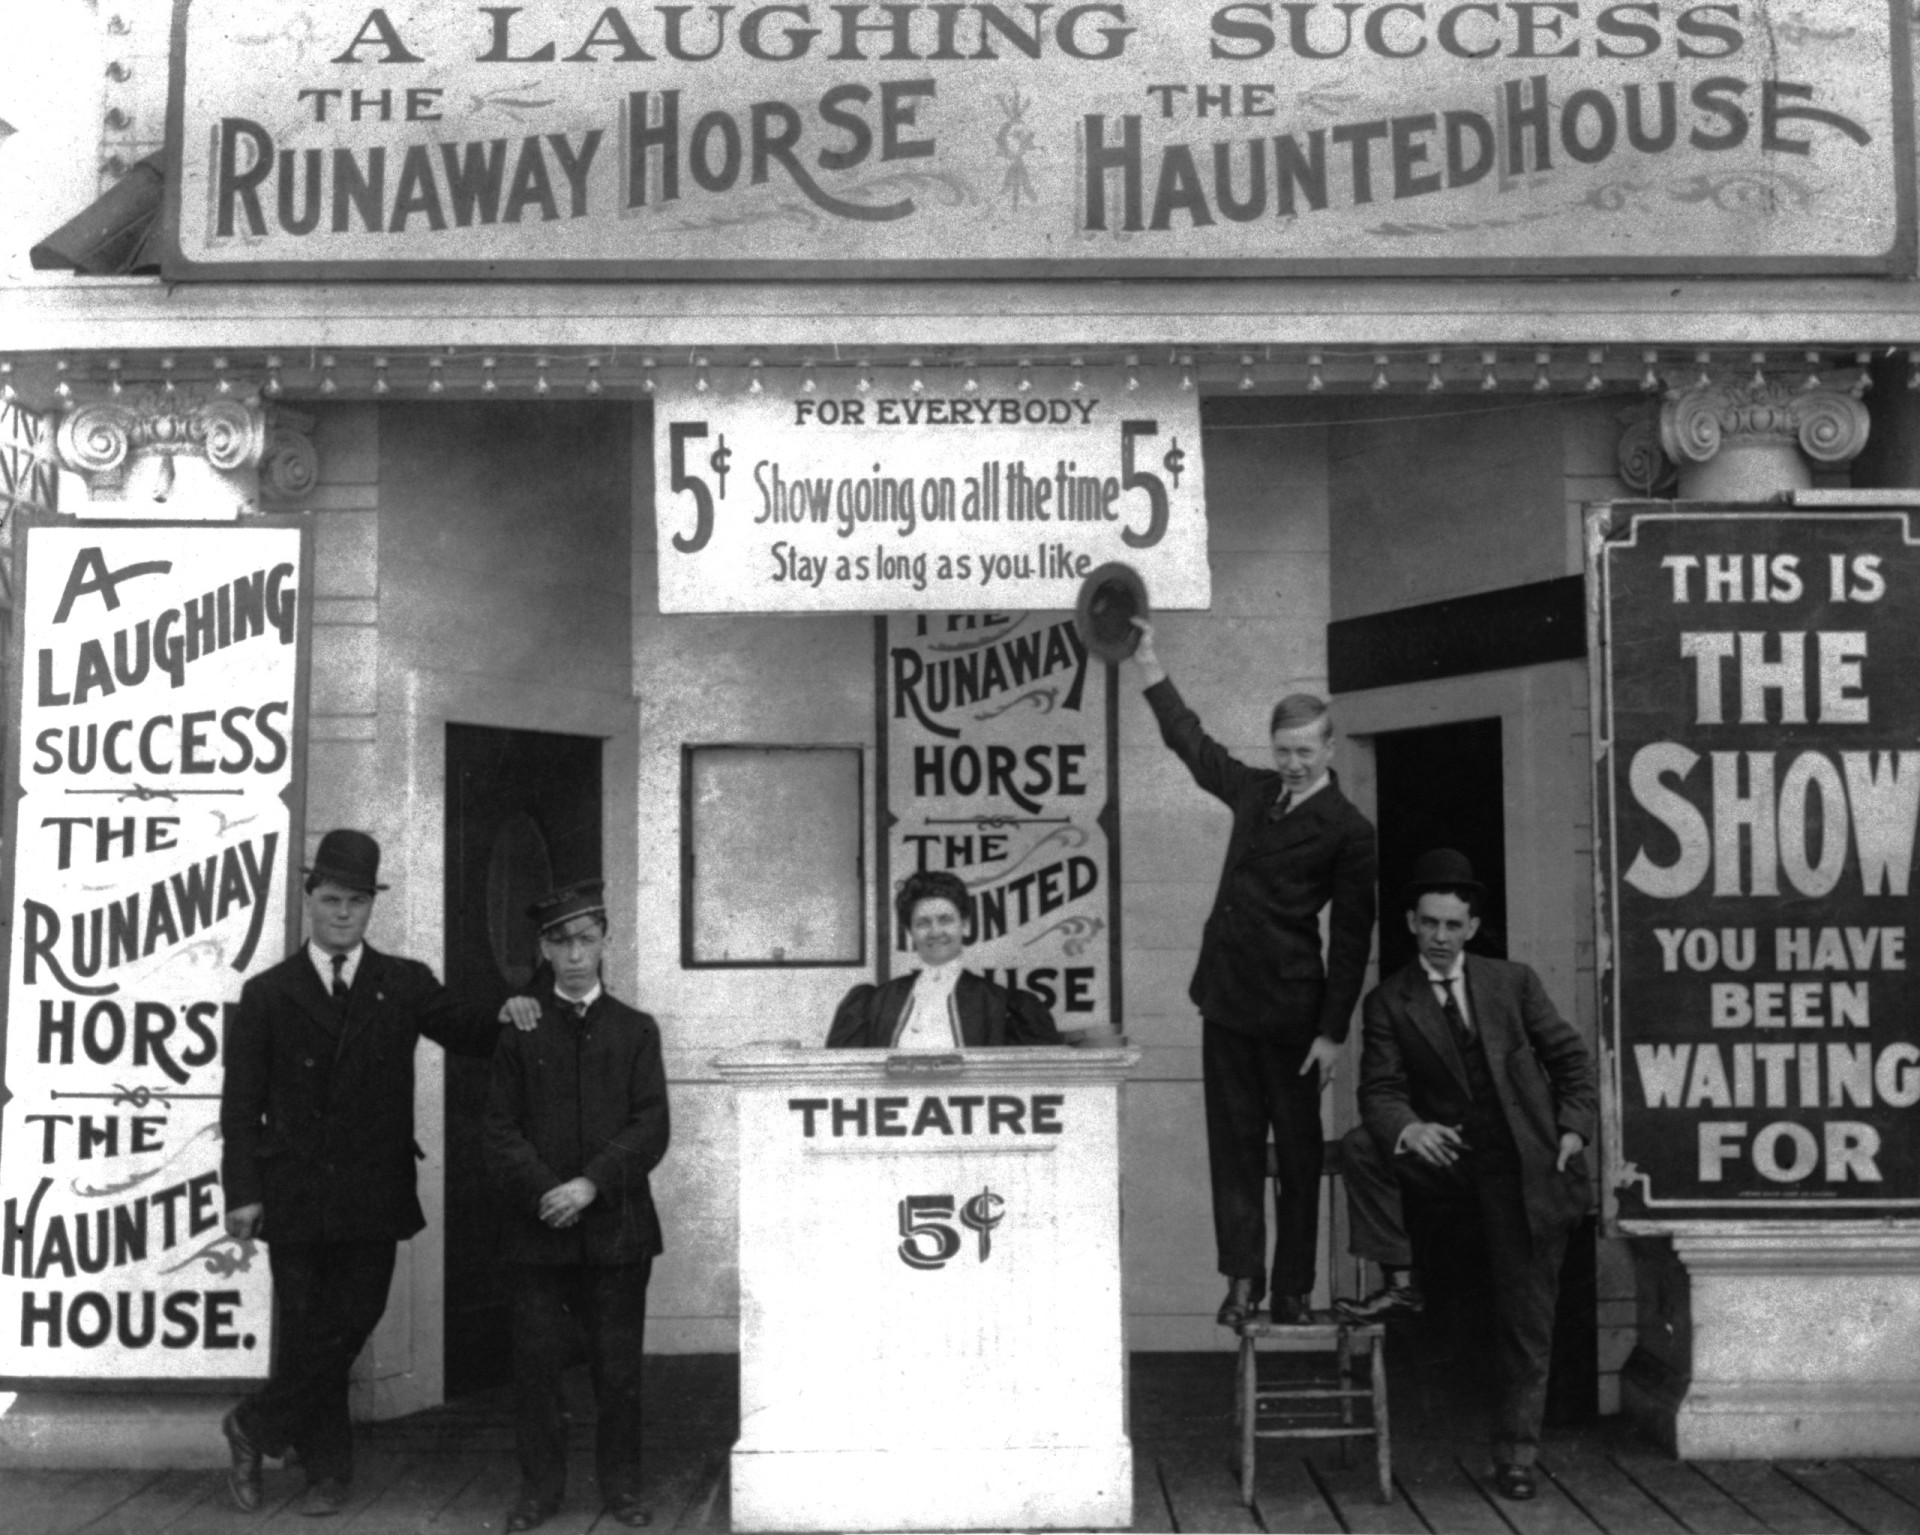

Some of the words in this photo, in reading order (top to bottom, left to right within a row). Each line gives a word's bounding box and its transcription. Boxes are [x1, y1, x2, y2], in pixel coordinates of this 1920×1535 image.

[330, 7, 427, 63] A
[476, 4, 1138, 63] LAUGHING
[1210, 2, 1745, 60] SUCCESS
[298, 87, 445, 122] THE
[1147, 84, 1276, 119] THE
[209, 117, 605, 238] RUNAWAY
[624, 78, 938, 222] HORSE
[1079, 110, 1496, 233] HAUNTED
[1502, 74, 1872, 174] HOUSE
[795, 399, 865, 425] FOR
[877, 399, 1100, 425] EVERYBODY
[753, 459, 833, 524] Show
[836, 462, 916, 538] going
[921, 477, 956, 523] on
[961, 460, 1000, 522] all
[1005, 460, 1052, 522] the
[1055, 460, 1120, 522] time
[52, 546, 173, 624] A
[771, 541, 828, 588] Stay
[835, 552, 869, 580] as
[876, 545, 928, 591] long
[937, 553, 972, 580] as
[1038, 542, 1092, 579] like
[1661, 553, 1804, 603] THIS
[1829, 553, 1887, 603] IS
[38, 562, 297, 707] LAUGHING
[890, 619, 1088, 739] RUNAWAY
[1680, 631, 1870, 724] THE
[33, 701, 288, 775] SUCCESS
[914, 744, 1087, 815] HORSE
[40, 816, 181, 870] THE
[1623, 741, 1920, 899] SHOW
[903, 835, 1008, 873] THE
[23, 831, 279, 996] RUNAWAY
[1653, 928, 1756, 972] YOU
[1775, 926, 1906, 971] HAVE
[1711, 981, 1870, 1028] BEEN
[38, 1000, 237, 1085] HORS
[1633, 1042, 1920, 1108] WAITING
[25, 1114, 168, 1164] THE
[788, 1095, 1065, 1137] THEATRE
[1698, 1121, 1883, 1182] FOR
[2, 1169, 221, 1279] HAUNTE
[898, 1186, 1006, 1270] 5¢
[20, 1290, 257, 1349] HOUSE.
